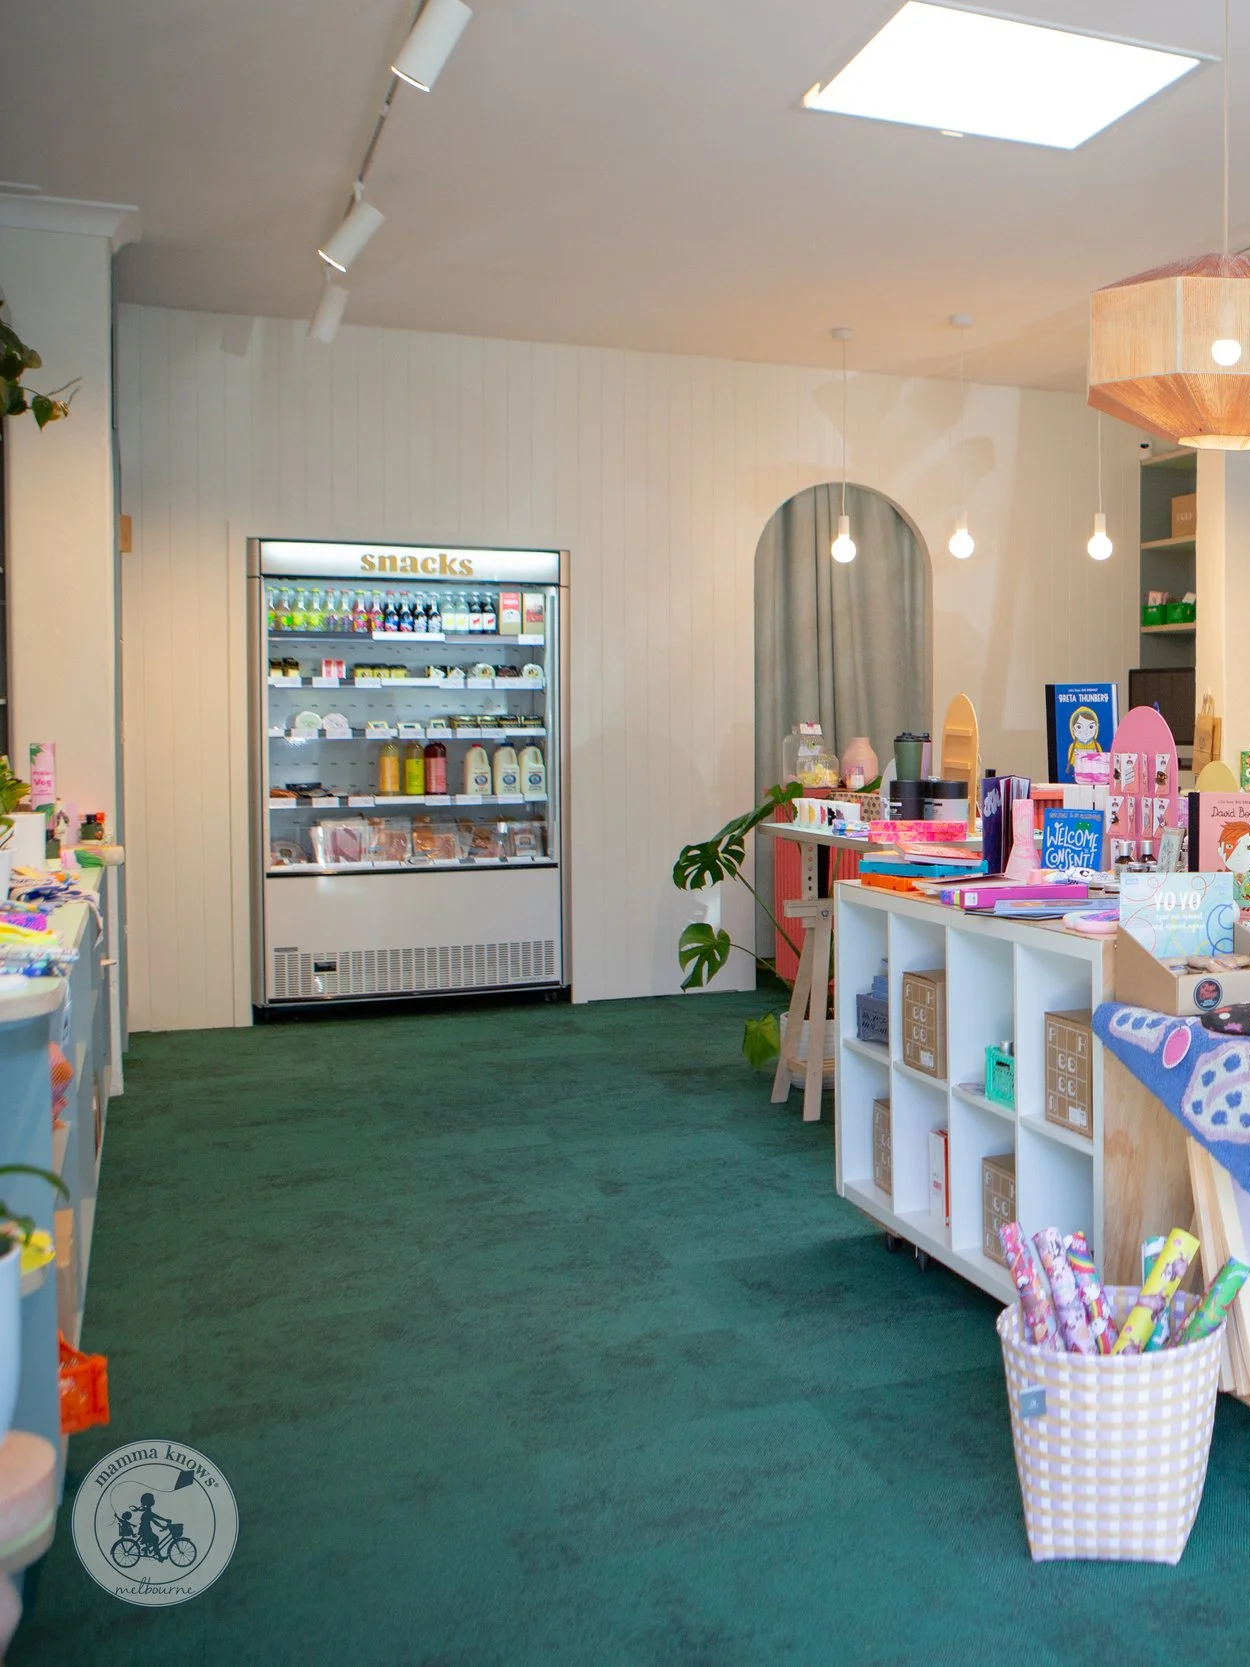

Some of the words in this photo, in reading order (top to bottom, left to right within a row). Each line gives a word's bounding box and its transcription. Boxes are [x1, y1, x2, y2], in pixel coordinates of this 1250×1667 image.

[360, 553, 474, 576] snacks
[1058, 693, 1077, 703] GRETA
[1078, 693, 1109, 703] THUNBERG
[1210, 805, 1236, 818] David
[1046, 822, 1099, 852] WELCOME
[1045, 848, 1095, 871] CONSENT!
